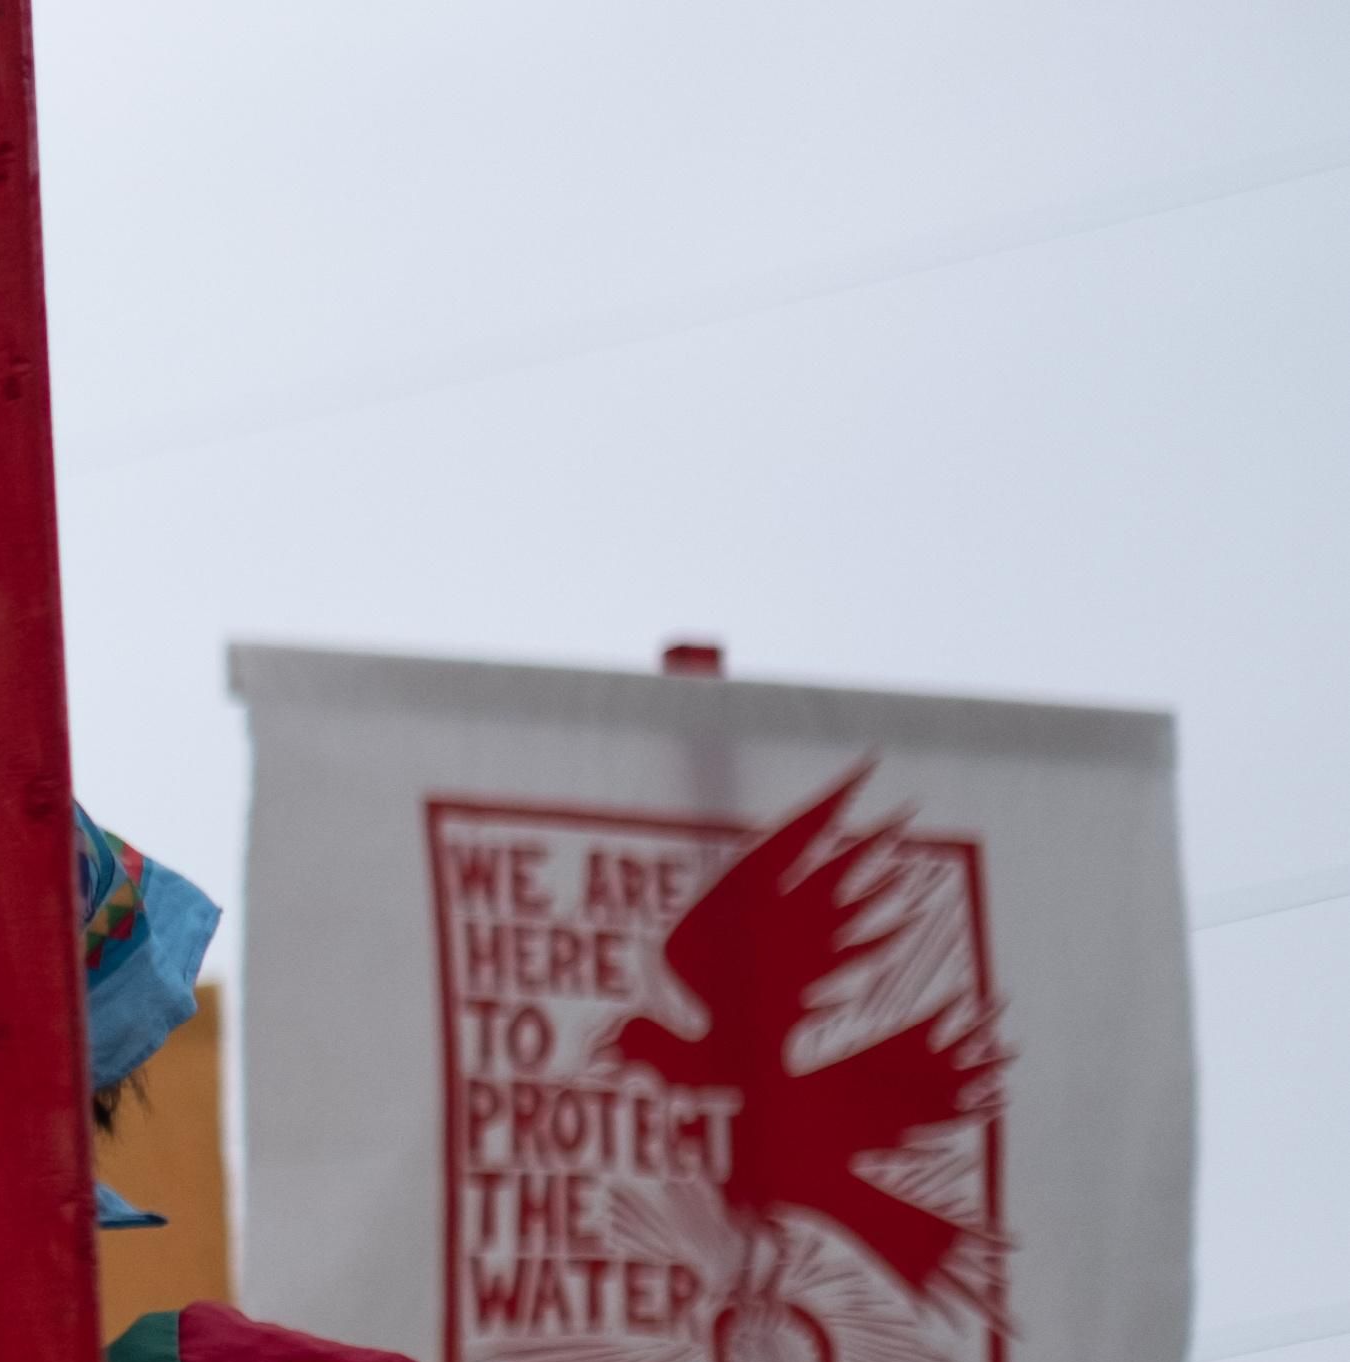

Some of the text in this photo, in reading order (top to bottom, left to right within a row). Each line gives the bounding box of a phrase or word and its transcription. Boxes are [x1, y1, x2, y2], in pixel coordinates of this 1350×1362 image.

[451, 842, 688, 918] WE ARE
[464, 921, 630, 998] HERE
[464, 1001, 555, 1074] TO
[466, 1082, 743, 1184] PROTECT
[467, 1173, 603, 1250] THE
[468, 1256, 701, 1336] WATER
